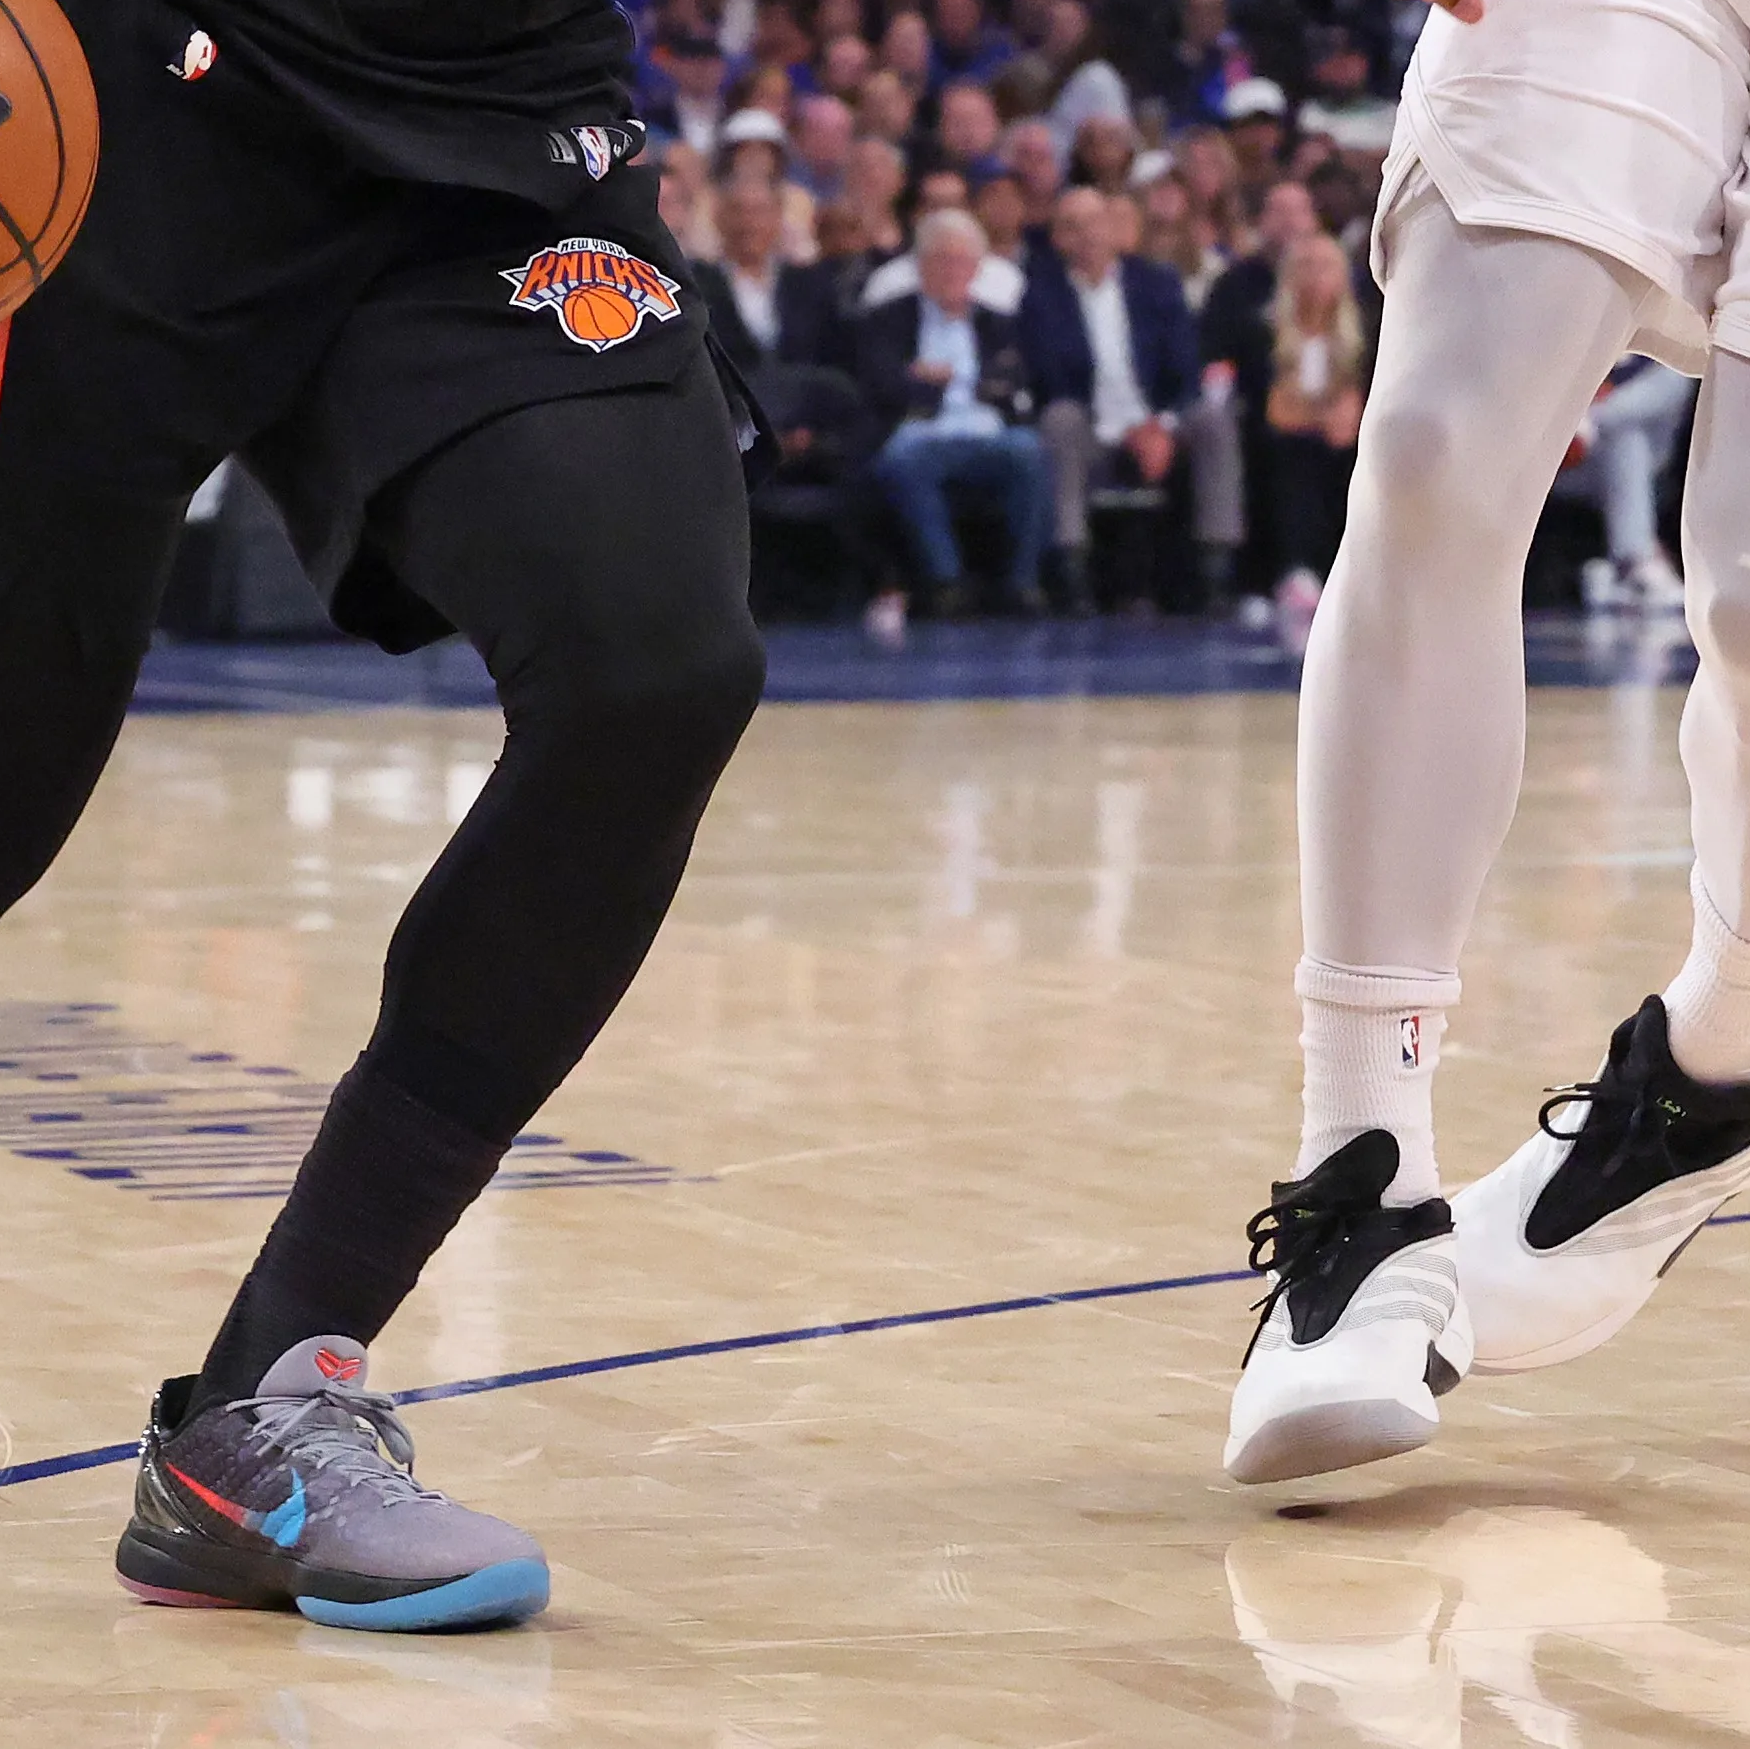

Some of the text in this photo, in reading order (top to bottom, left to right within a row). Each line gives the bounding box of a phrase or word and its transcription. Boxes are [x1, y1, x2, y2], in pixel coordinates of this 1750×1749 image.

[560, 239, 626, 258] NEW YORK
[516, 251, 677, 311] KNICKS
